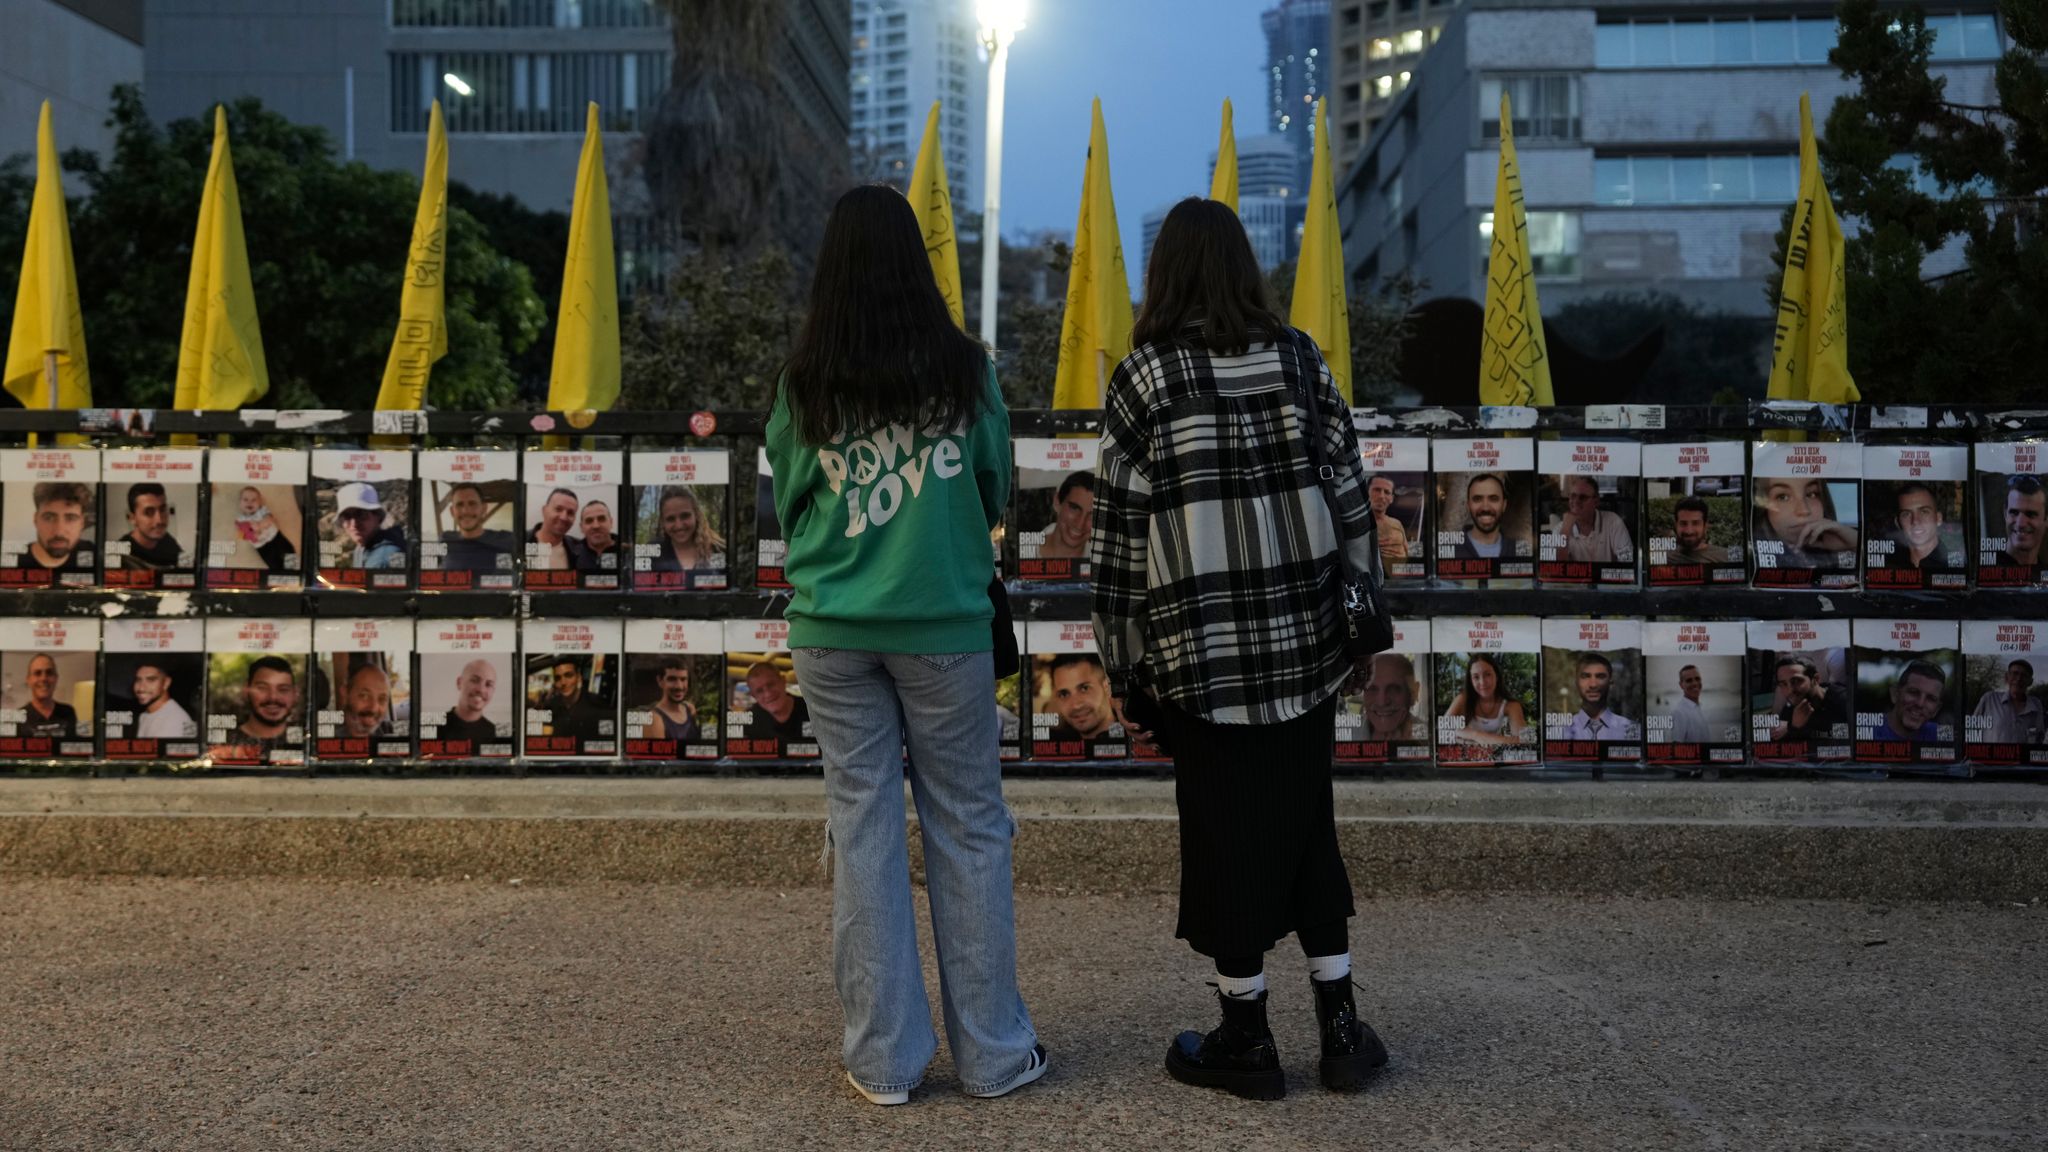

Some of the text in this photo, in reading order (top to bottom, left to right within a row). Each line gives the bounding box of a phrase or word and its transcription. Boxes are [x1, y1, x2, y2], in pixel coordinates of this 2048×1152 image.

[1786, 456, 1803, 464] AGAM
[1792, 466, 1808, 474] (20)
[1020, 532, 1045, 545] BRING
[1438, 531, 1464, 545] BRING
[1540, 535, 1566, 547] BRING
[1650, 538, 1676, 550] BRING
[1980, 538, 2007, 551] BRING
[635, 544, 661, 557] BRING
[760, 540, 785, 553] BRING
[1020, 546, 1036, 558] HIM
[1438, 546, 1455, 558] HIM
[1757, 541, 1784, 554] BRING
[1868, 540, 1894, 553] BRING
[758, 553, 775, 566] HIM
[1540, 548, 1556, 561] HIM
[1650, 551, 1667, 565] HIM
[1868, 554, 1885, 567] HIM
[1980, 552, 1996, 565] HIM
[635, 558, 651, 570] HER
[1020, 560, 1071, 573] HOME NOW!
[1438, 560, 1463, 574] HOME
[1466, 560, 1490, 573] NOW!
[1759, 555, 1776, 568] HER
[1540, 564, 1565, 577] HOME
[1567, 562, 1592, 576] NOW!
[1868, 570, 1893, 582] HOME
[1895, 569, 1921, 582] NOW!
[626, 712, 652, 724] BRING
[727, 712, 753, 724] BRING
[1033, 713, 1059, 726] BRING
[1336, 715, 1361, 727] BRING
[1438, 716, 1465, 729] BRING
[1546, 713, 1572, 726] BRING
[1647, 716, 1672, 728] BRING
[1753, 715, 1779, 727] BRING
[1857, 713, 1883, 726] BRING
[1966, 715, 1993, 728] BRING
[626, 726, 643, 738] HIM
[727, 726, 743, 738] HIM
[1033, 727, 1049, 740] HIM
[1336, 728, 1352, 741] HIM
[1438, 730, 1456, 744] HER
[1546, 727, 1563, 740] HIM
[1647, 730, 1663, 742] HIM
[1754, 729, 1770, 742] HIM
[1857, 727, 1873, 740] HIM
[1966, 729, 1982, 743] HIM
[1033, 742, 1057, 754] HOME
[1060, 741, 1085, 754] NOW!
[1335, 743, 1387, 756] HOME NOW!
[1546, 742, 1598, 754] HOME NOW!
[1755, 744, 1779, 756] HOME
[1781, 743, 1807, 756] NOW!
[1857, 742, 1881, 755] HOME
[1883, 742, 1910, 755] NOW!
